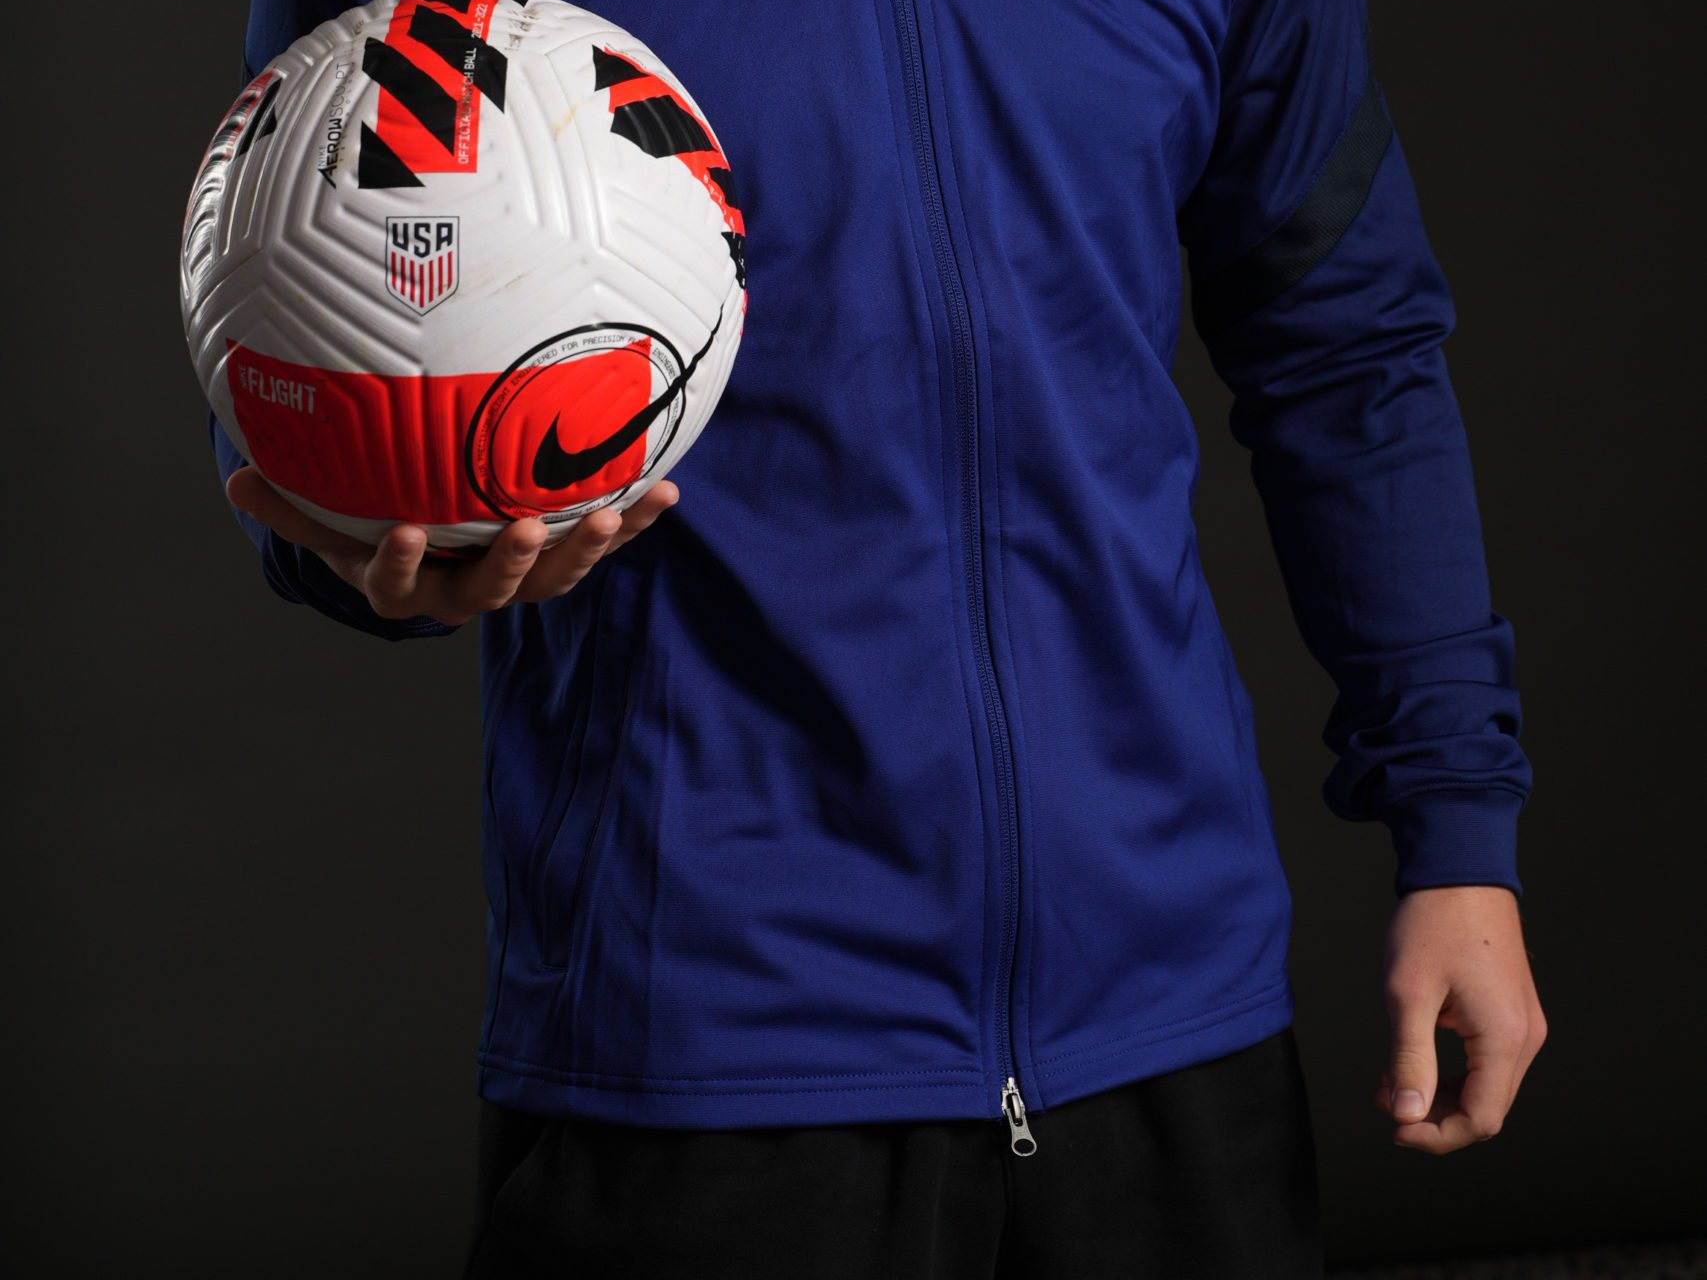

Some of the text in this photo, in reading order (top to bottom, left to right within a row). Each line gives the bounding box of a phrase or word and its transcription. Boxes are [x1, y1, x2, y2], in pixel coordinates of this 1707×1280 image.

[463, 48, 477, 69] BALL
[317, 144, 326, 168] NIKE
[392, 223, 453, 258] USA
[511, 349, 558, 387] ENGINEERED
[562, 341, 578, 352] FOR
[583, 335, 624, 346] PRECISION
[247, 367, 316, 414] FLIGHT
